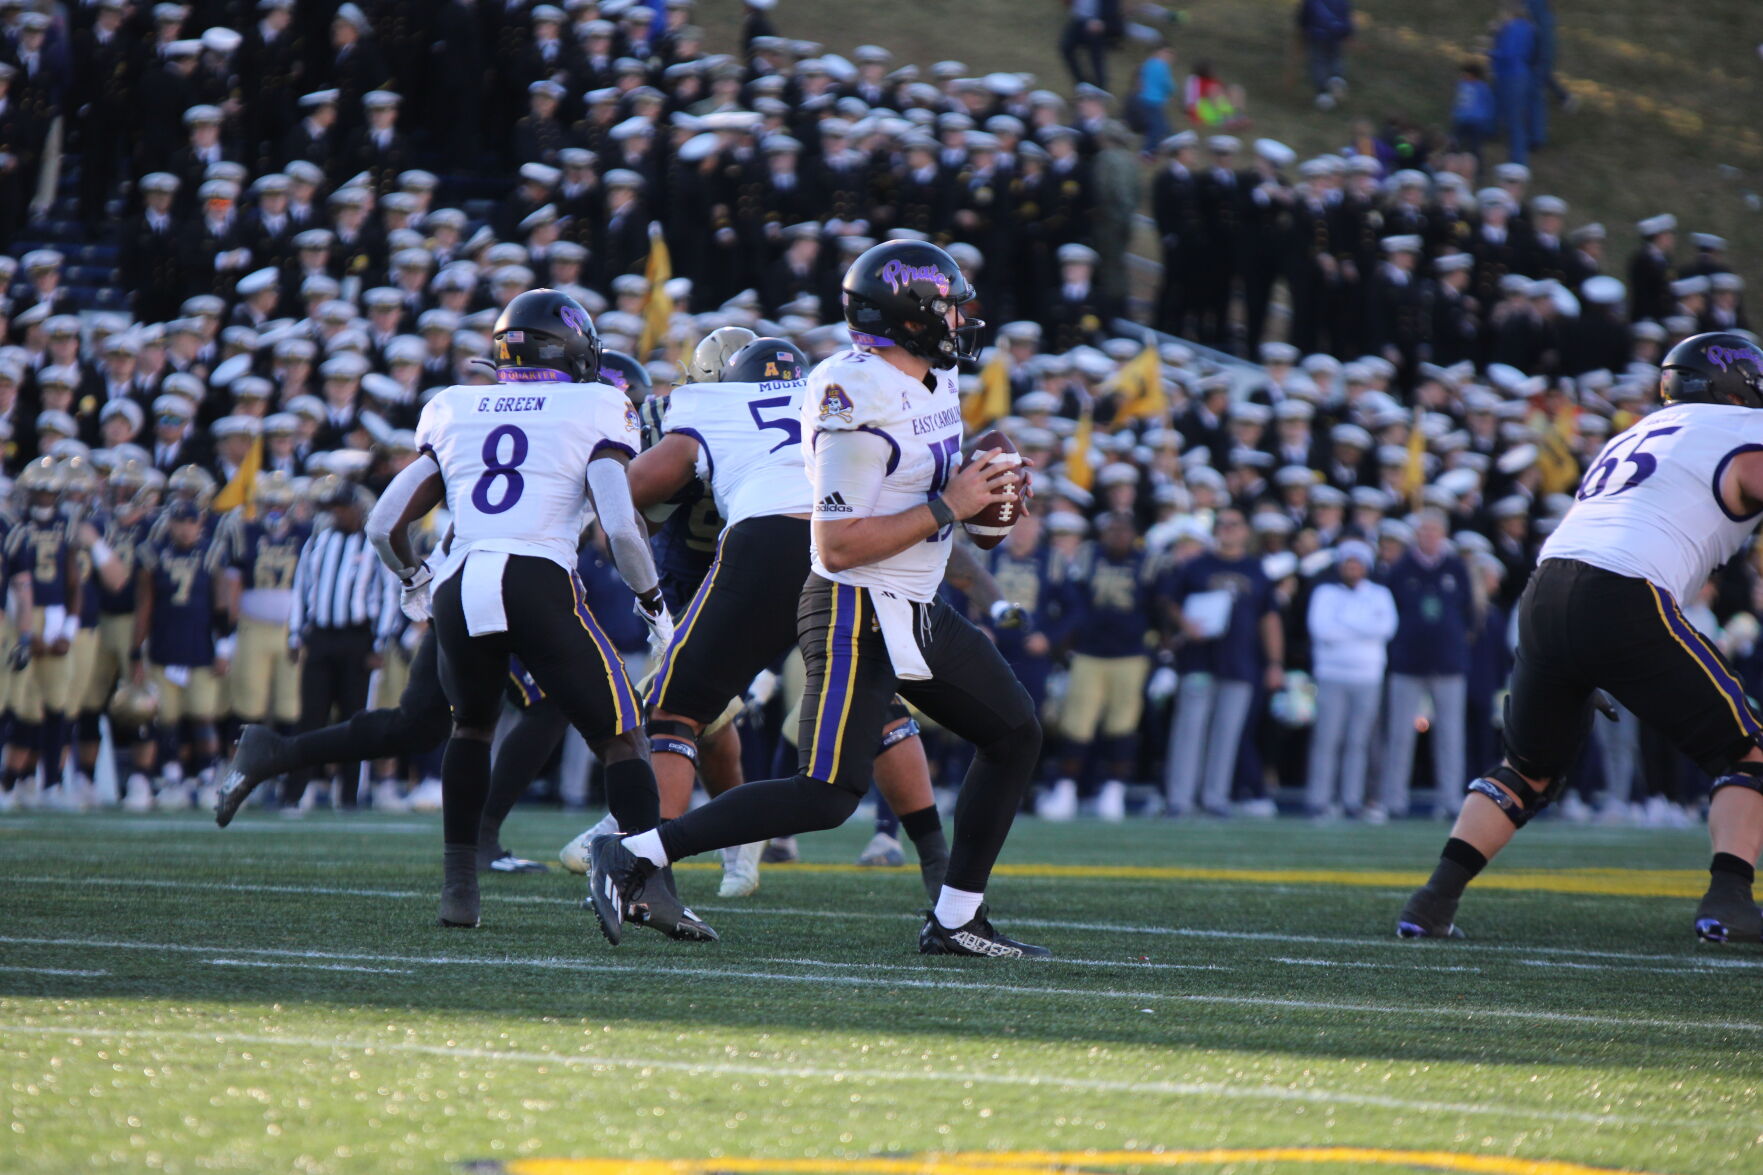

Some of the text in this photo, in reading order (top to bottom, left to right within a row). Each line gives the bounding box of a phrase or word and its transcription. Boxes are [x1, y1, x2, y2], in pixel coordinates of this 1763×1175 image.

[477, 396, 546, 412] G. GREEN
[747, 395, 802, 455] 5
[912, 414, 937, 436] EAST
[471, 424, 528, 514] 8
[1579, 426, 1684, 501] 65
[815, 504, 854, 512] adidas
